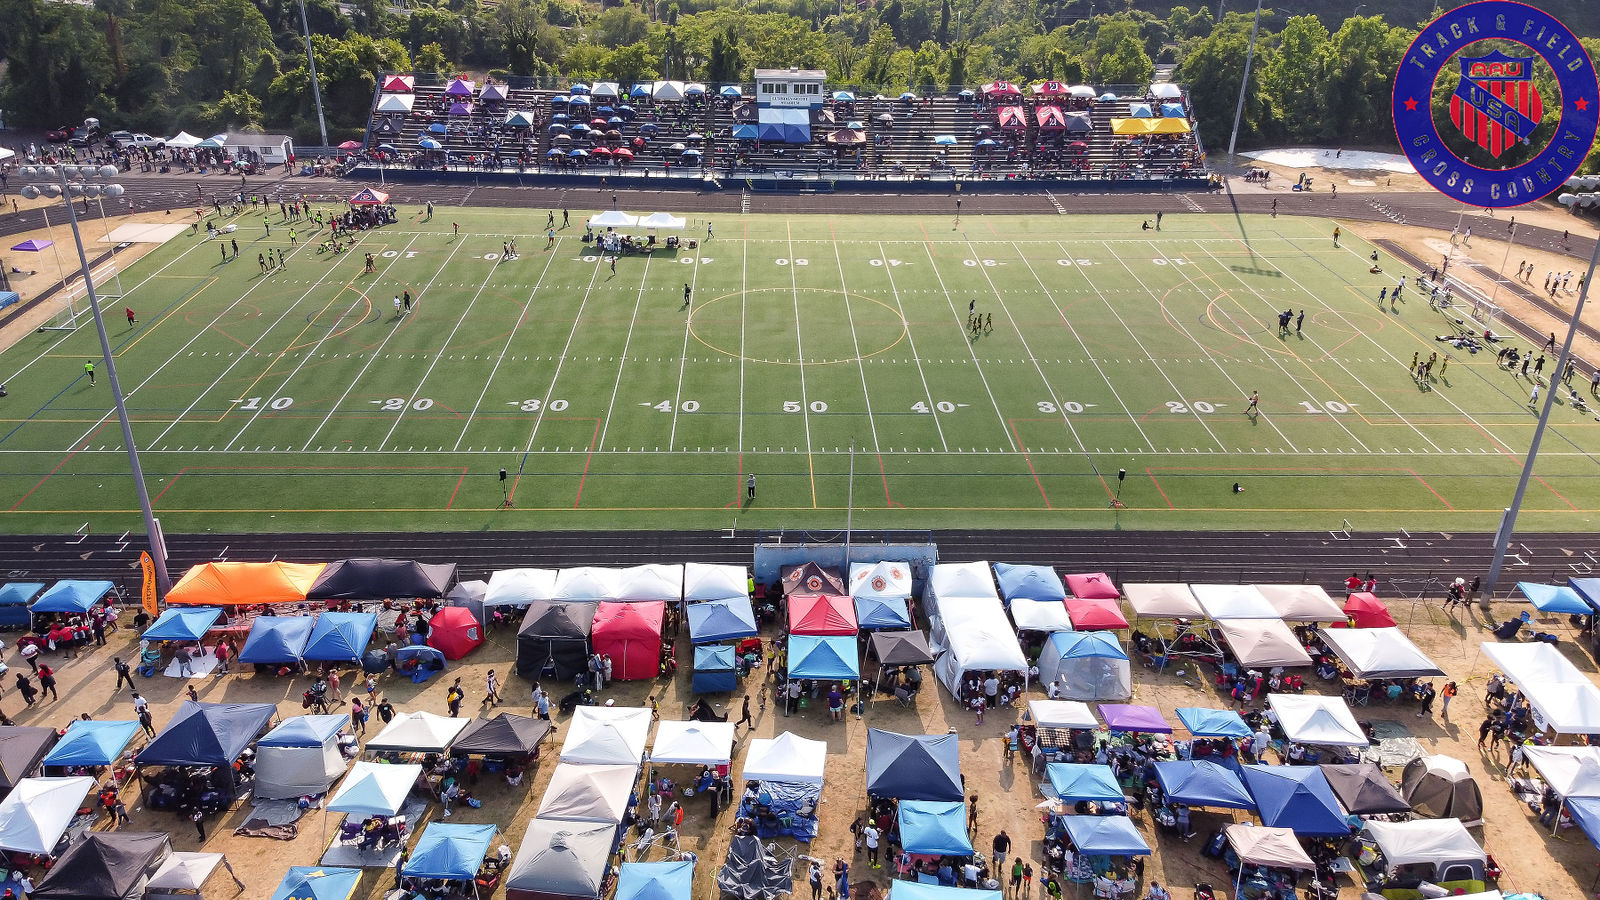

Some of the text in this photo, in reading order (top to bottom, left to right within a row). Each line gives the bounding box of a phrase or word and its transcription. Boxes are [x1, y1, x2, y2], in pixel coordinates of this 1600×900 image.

[381, 250, 420, 258] 10
[680, 257, 715, 265] 40
[775, 258, 809, 266] 50
[240, 396, 294, 411] 10
[382, 397, 436, 412] 20
[521, 399, 570, 412] 30
[653, 400, 702, 413] 40
[782, 401, 829, 414] 50
[910, 401, 957, 414] 40
[1037, 401, 1085, 414] 30
[1165, 401, 1215, 415] 20
[1298, 400, 1350, 415] 10
